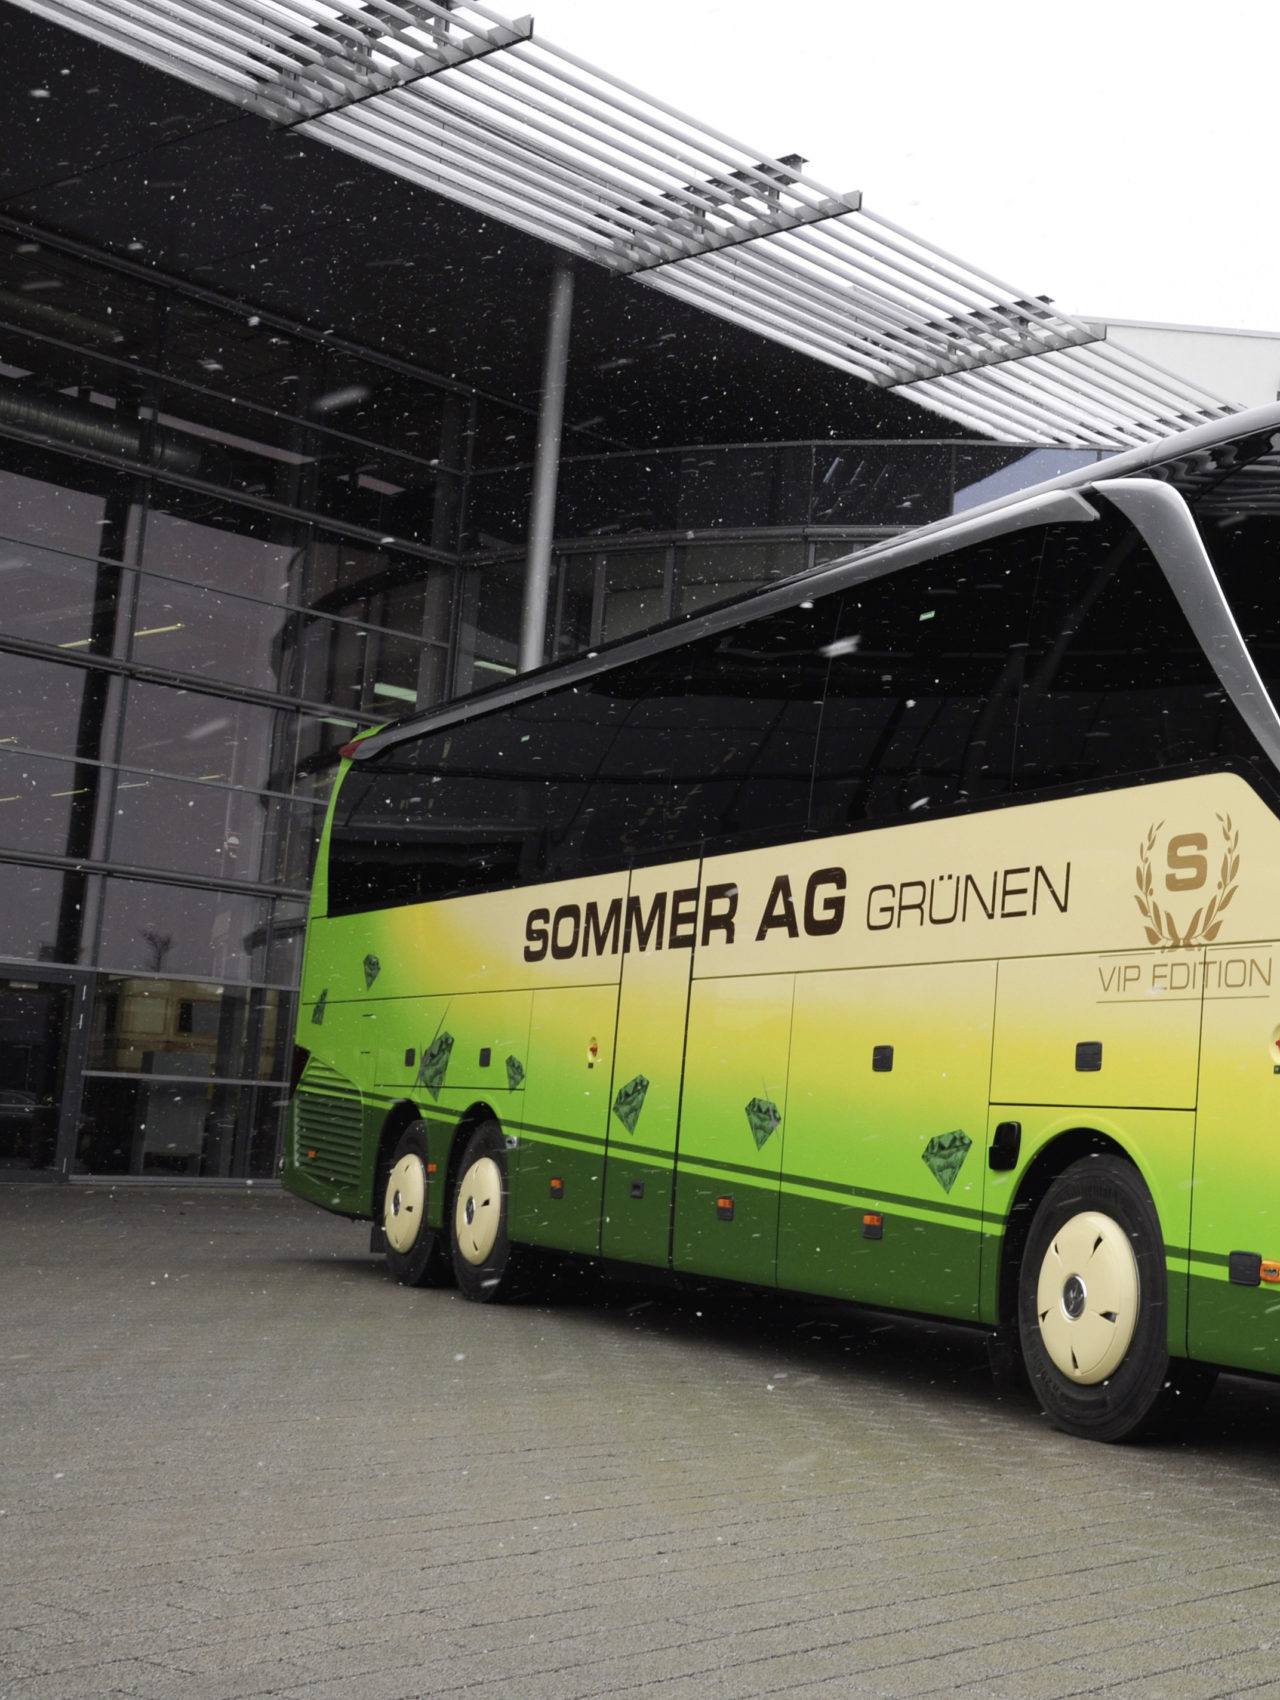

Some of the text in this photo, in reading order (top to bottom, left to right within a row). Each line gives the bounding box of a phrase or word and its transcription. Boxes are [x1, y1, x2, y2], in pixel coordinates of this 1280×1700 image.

[1165, 832, 1209, 892] S
[523, 862, 1072, 963] SOMMER AG GRÜNEN
[1098, 958, 1273, 994] VIP EDITION
